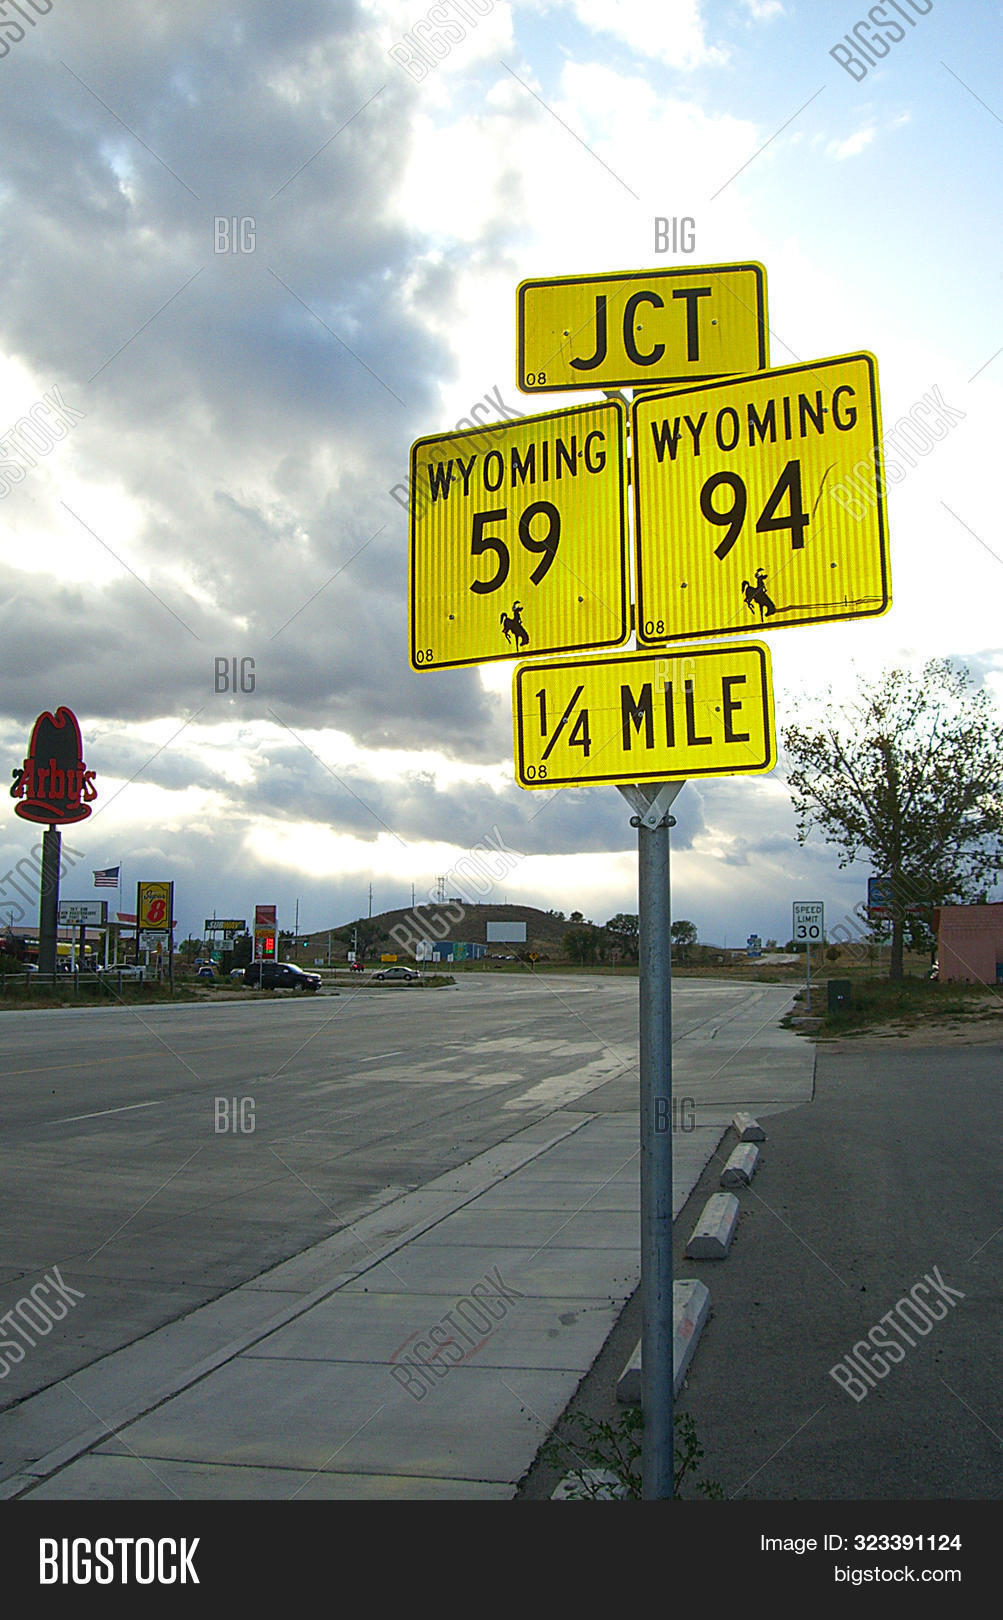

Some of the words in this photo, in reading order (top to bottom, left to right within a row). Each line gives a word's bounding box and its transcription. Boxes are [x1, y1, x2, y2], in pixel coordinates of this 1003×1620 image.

[568, 287, 712, 371] JCT
[526, 372, 547, 387] 08
[651, 384, 857, 463] WYOMING
[427, 430, 606, 502] WYOMING
[699, 460, 810, 561] 94
[469, 501, 562, 595] 59
[645, 620, 664, 635] 08
[416, 649, 434, 663] 08
[620, 674, 751, 752] MILE
[526, 765, 548, 780] 08
[11, 758, 98, 810] Arby's
[147, 899, 166, 922] 8
[795, 906, 822, 914] SPEED
[797, 915, 818, 923] LIMIT
[207, 921, 240, 930] SUBWAY
[797, 925, 820, 938] 30
